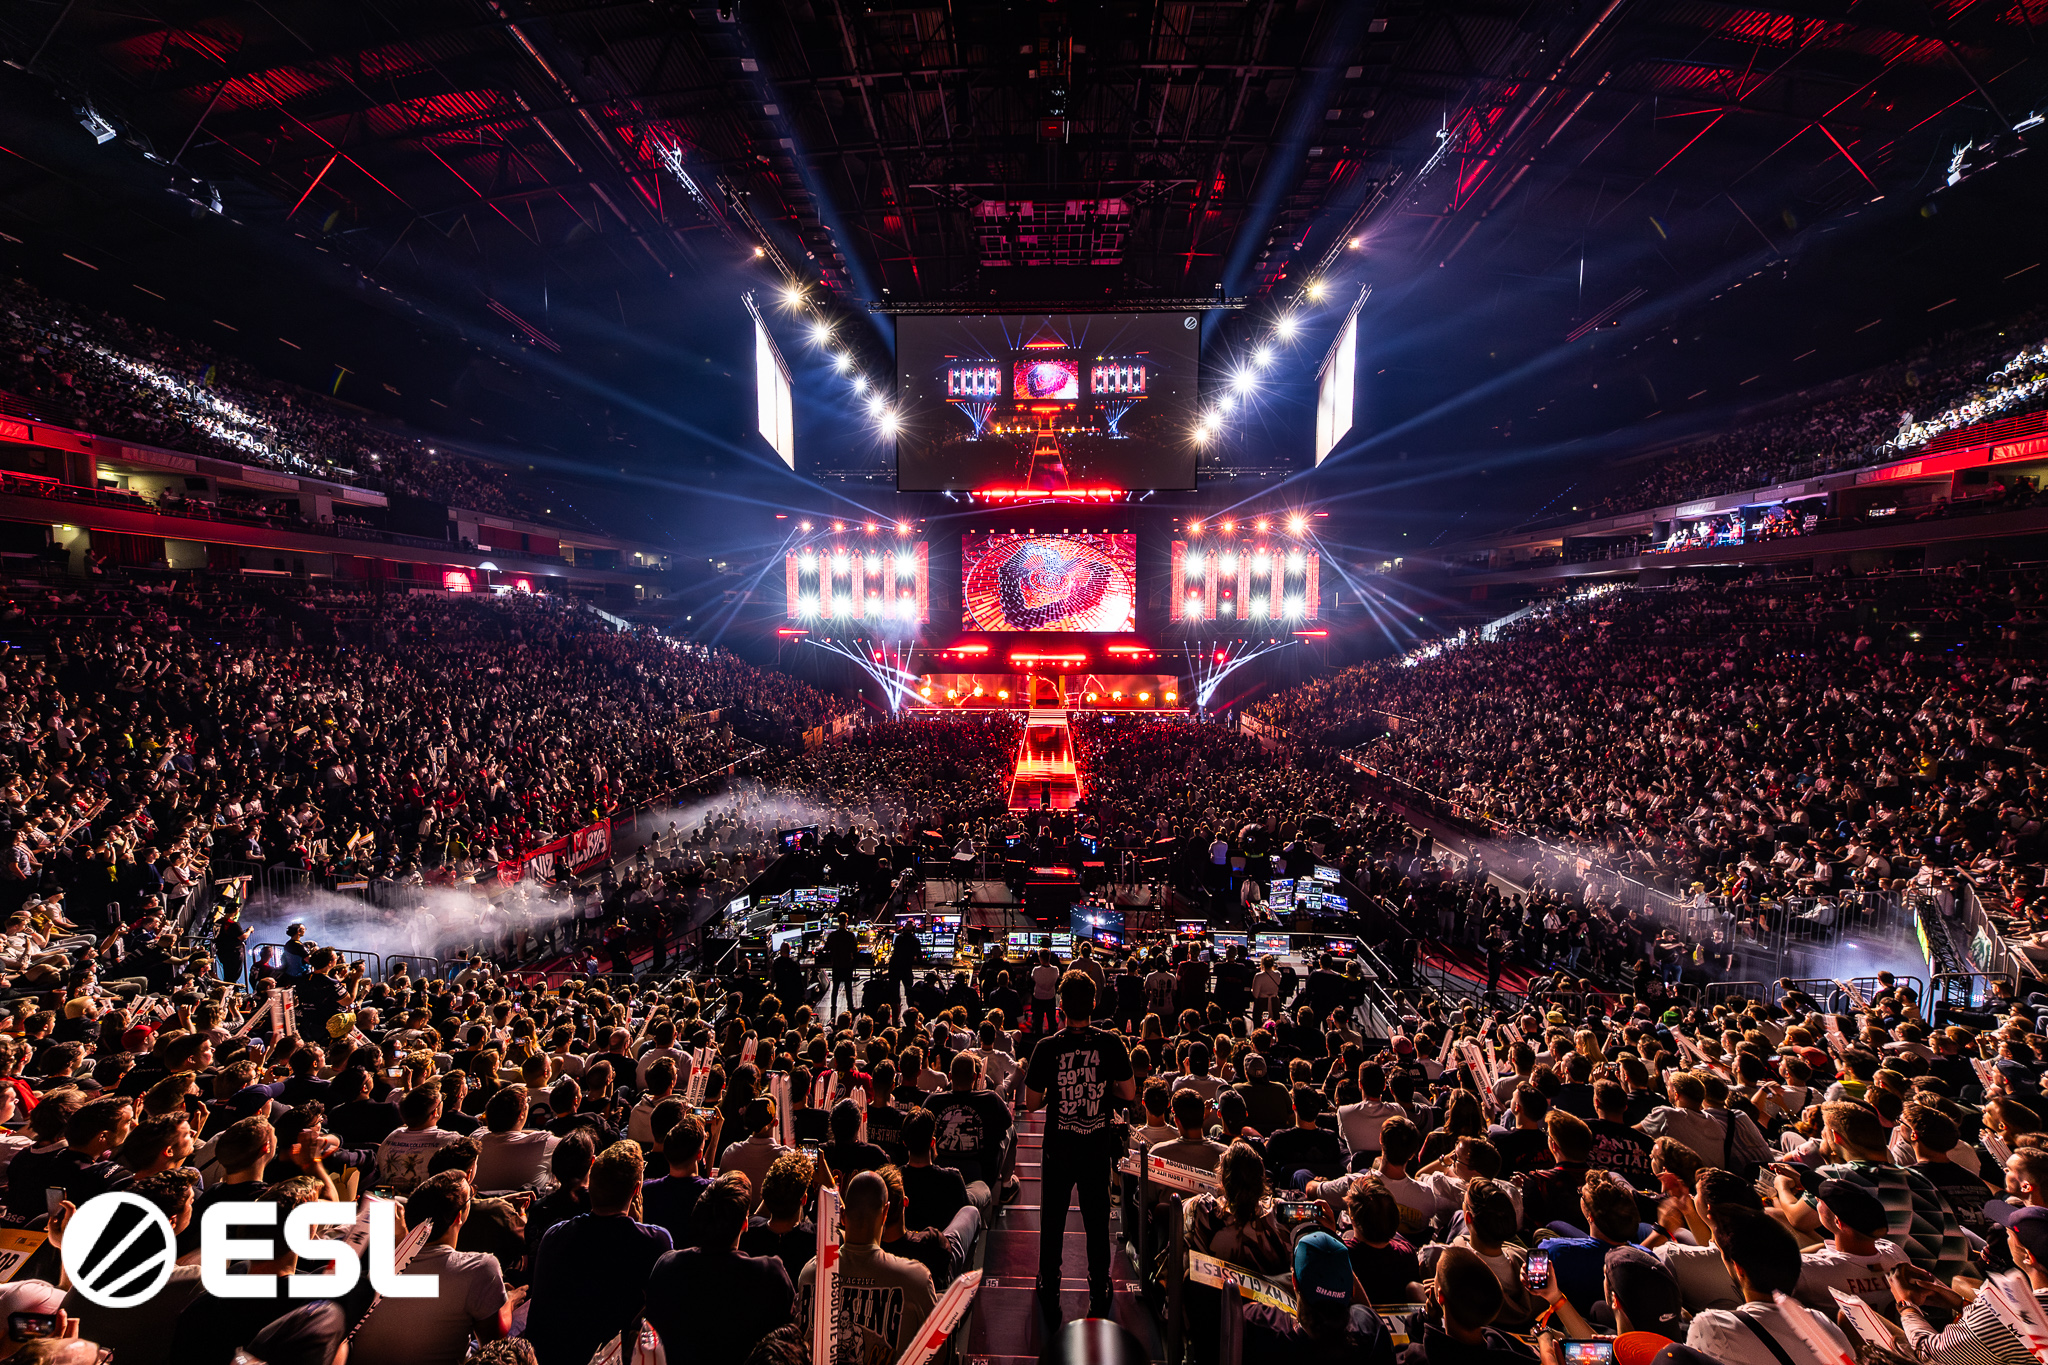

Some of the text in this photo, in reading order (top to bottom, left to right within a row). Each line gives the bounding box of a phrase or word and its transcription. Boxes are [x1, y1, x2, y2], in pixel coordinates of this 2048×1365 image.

[846, 1277, 876, 1286] ACTIVE
[1846, 1277, 1883, 1294] FAZE
[1265, 1285, 1284, 1303] MY
[1316, 1285, 1346, 1299] SHARKS
[829, 1272, 841, 1342] ABSOLUTE
[801, 1284, 905, 1351] BKING
[1841, 1304, 1865, 1332] intel
